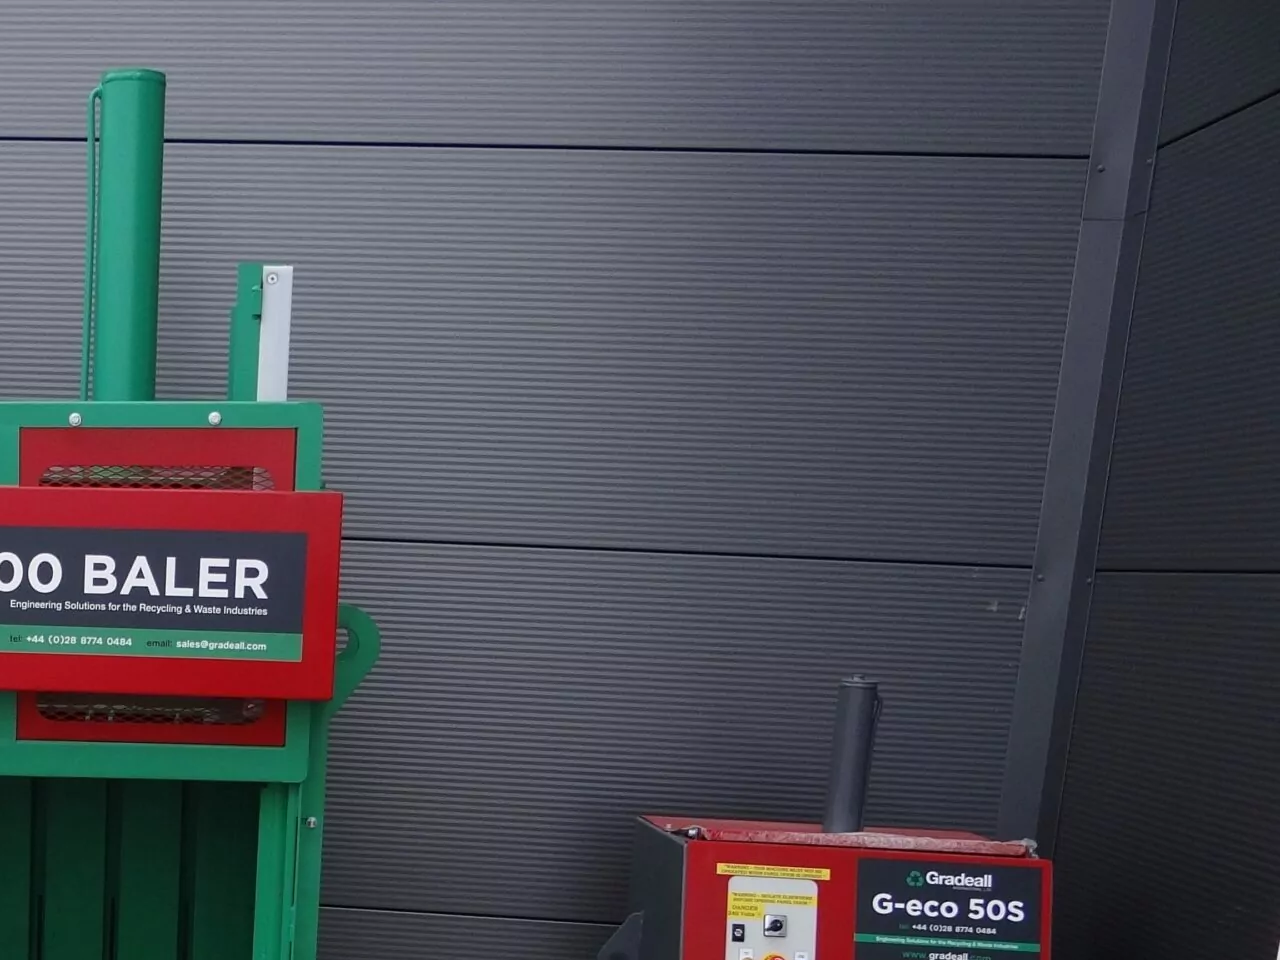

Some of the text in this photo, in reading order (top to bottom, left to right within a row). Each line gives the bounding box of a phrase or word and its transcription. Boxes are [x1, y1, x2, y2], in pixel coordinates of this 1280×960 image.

[83, 554, 269, 600] BALER
[10, 599, 268, 616] Engineering Solutions for the Recycling & Waste Industries
[26, 635, 45, 644] +44
[48, 634, 77, 645] (0)28
[80, 636, 103, 645] 8774
[106, 637, 133, 646] 0484
[146, 639, 268, 651] email: sales@gradeall.com
[925, 871, 993, 888] Gradeall
[872, 892, 1025, 923] G-eco 50S
